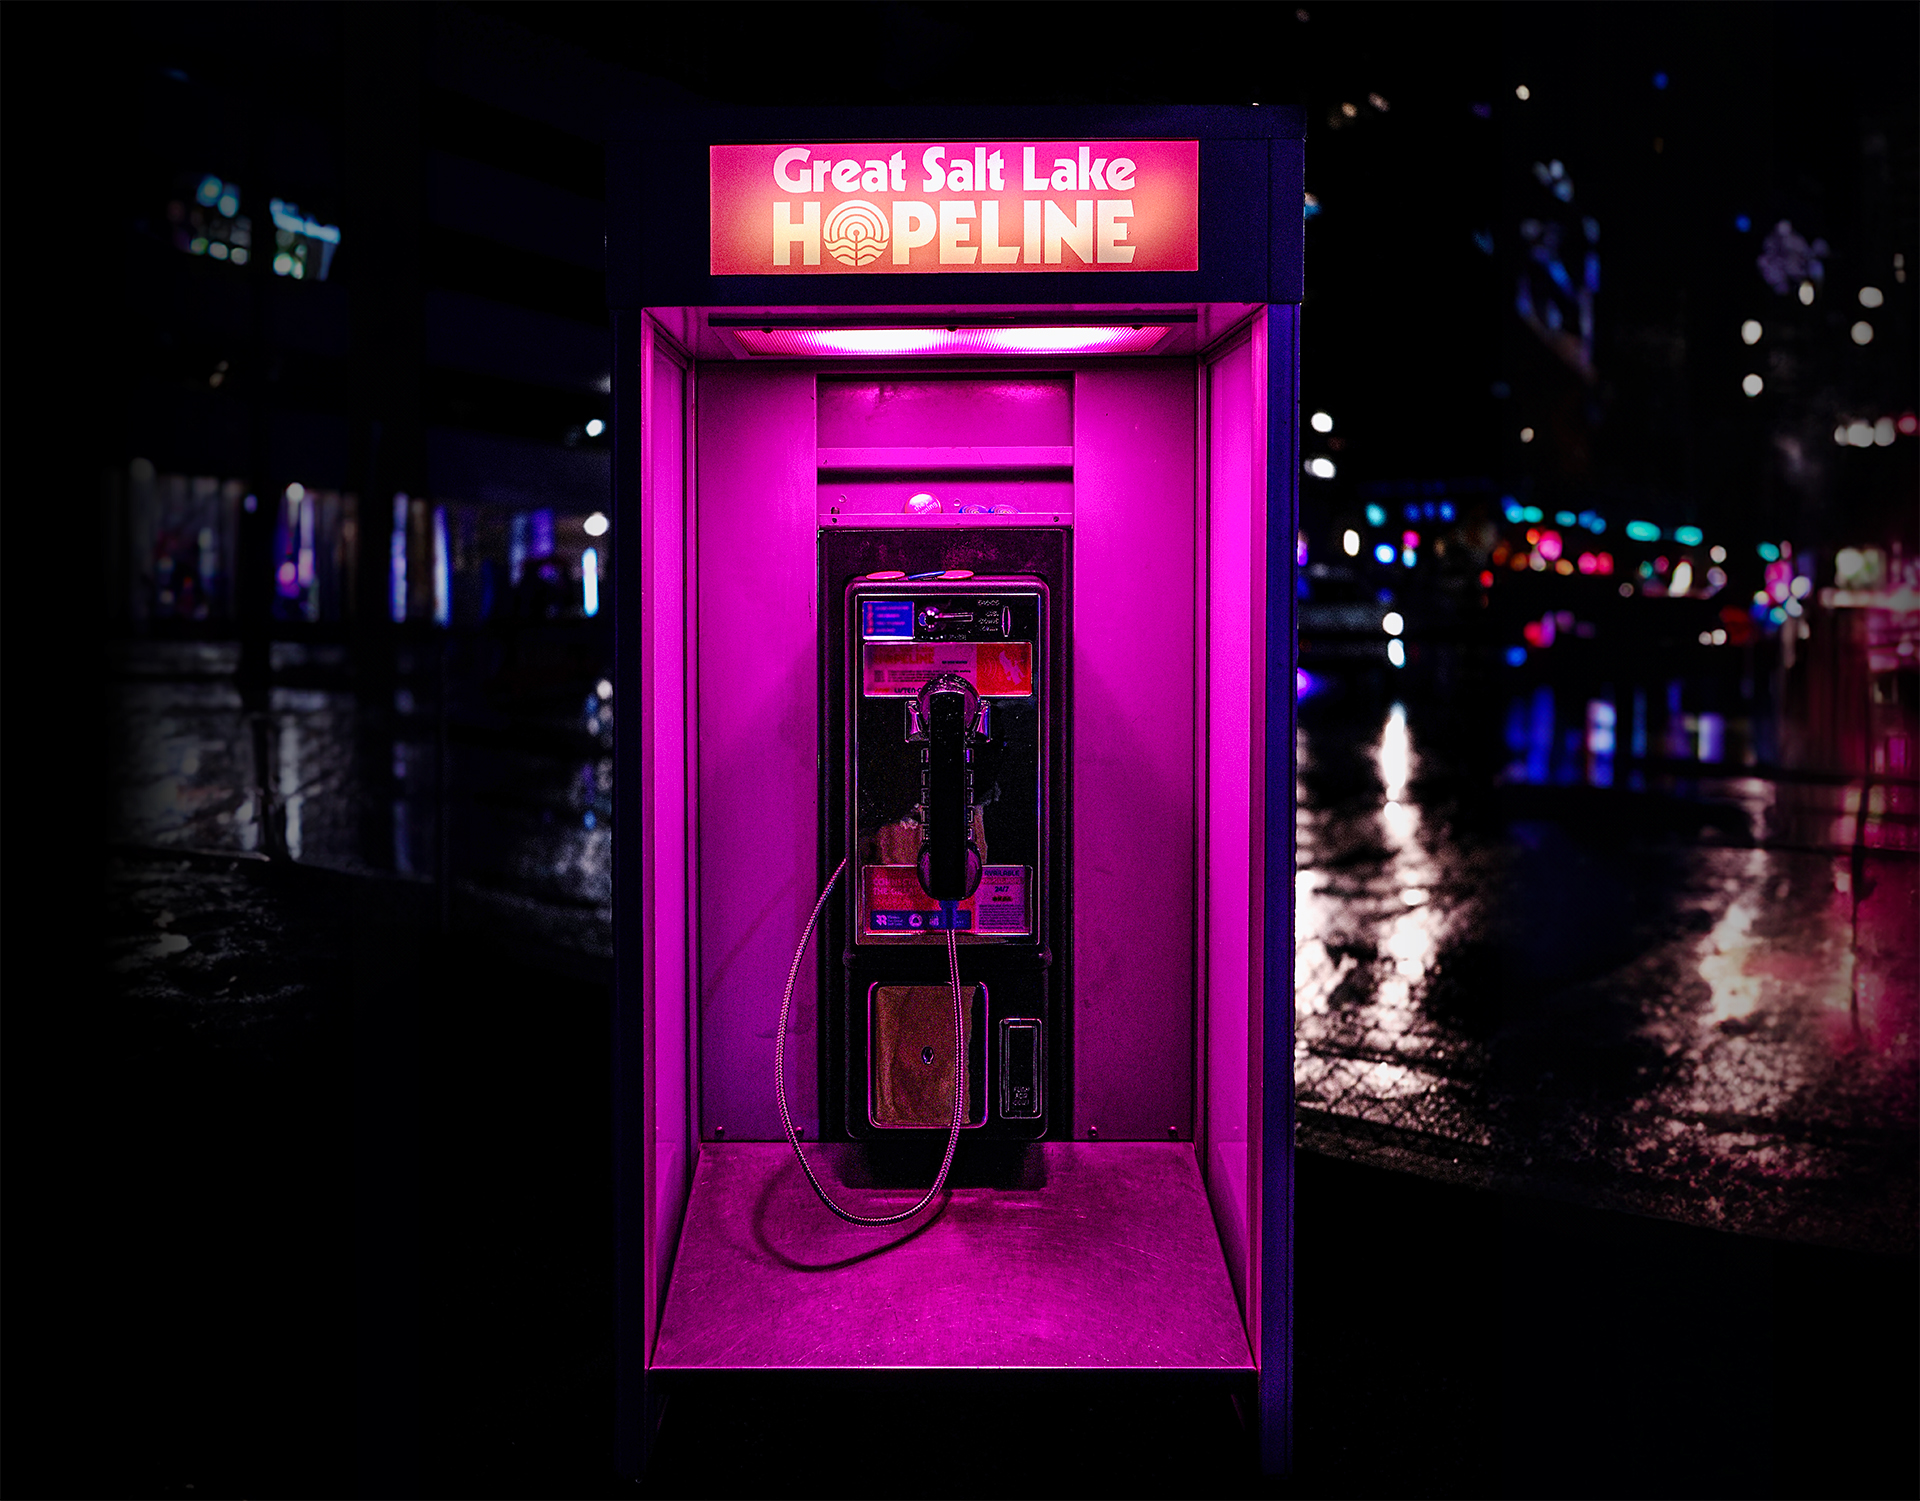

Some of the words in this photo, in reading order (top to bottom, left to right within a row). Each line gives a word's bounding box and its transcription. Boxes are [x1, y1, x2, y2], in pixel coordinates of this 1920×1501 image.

[773, 147, 907, 194] Great
[922, 146, 1005, 193] Salt
[1023, 146, 1137, 192] Lake
[773, 199, 1137, 267] HOPELINE
